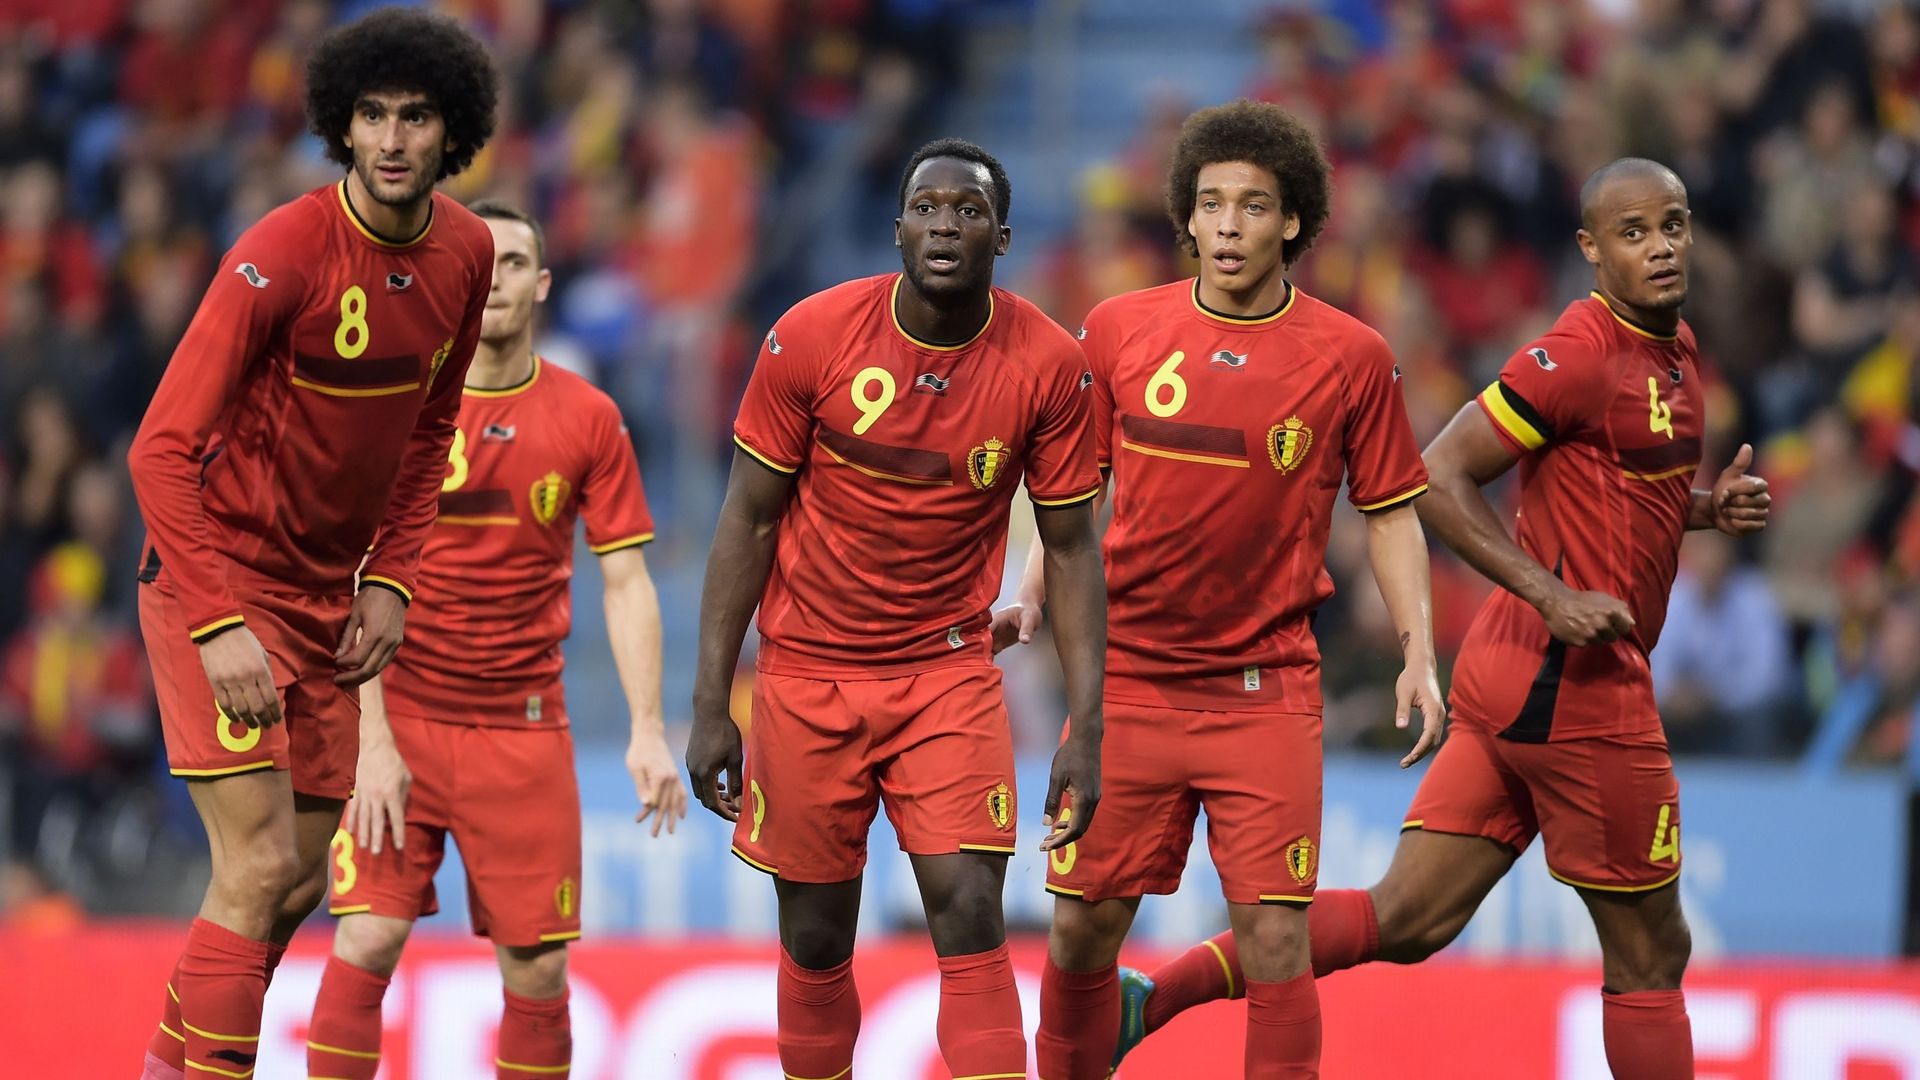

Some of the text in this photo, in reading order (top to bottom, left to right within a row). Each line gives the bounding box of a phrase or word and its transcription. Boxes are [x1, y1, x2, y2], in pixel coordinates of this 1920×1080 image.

[333, 285, 370, 360] 8
[850, 366, 897, 436] 9
[1144, 350, 1188, 418] 6
[1647, 376, 1674, 440] 4
[330, 827, 357, 896] 3
[1649, 804, 1679, 864] 4
